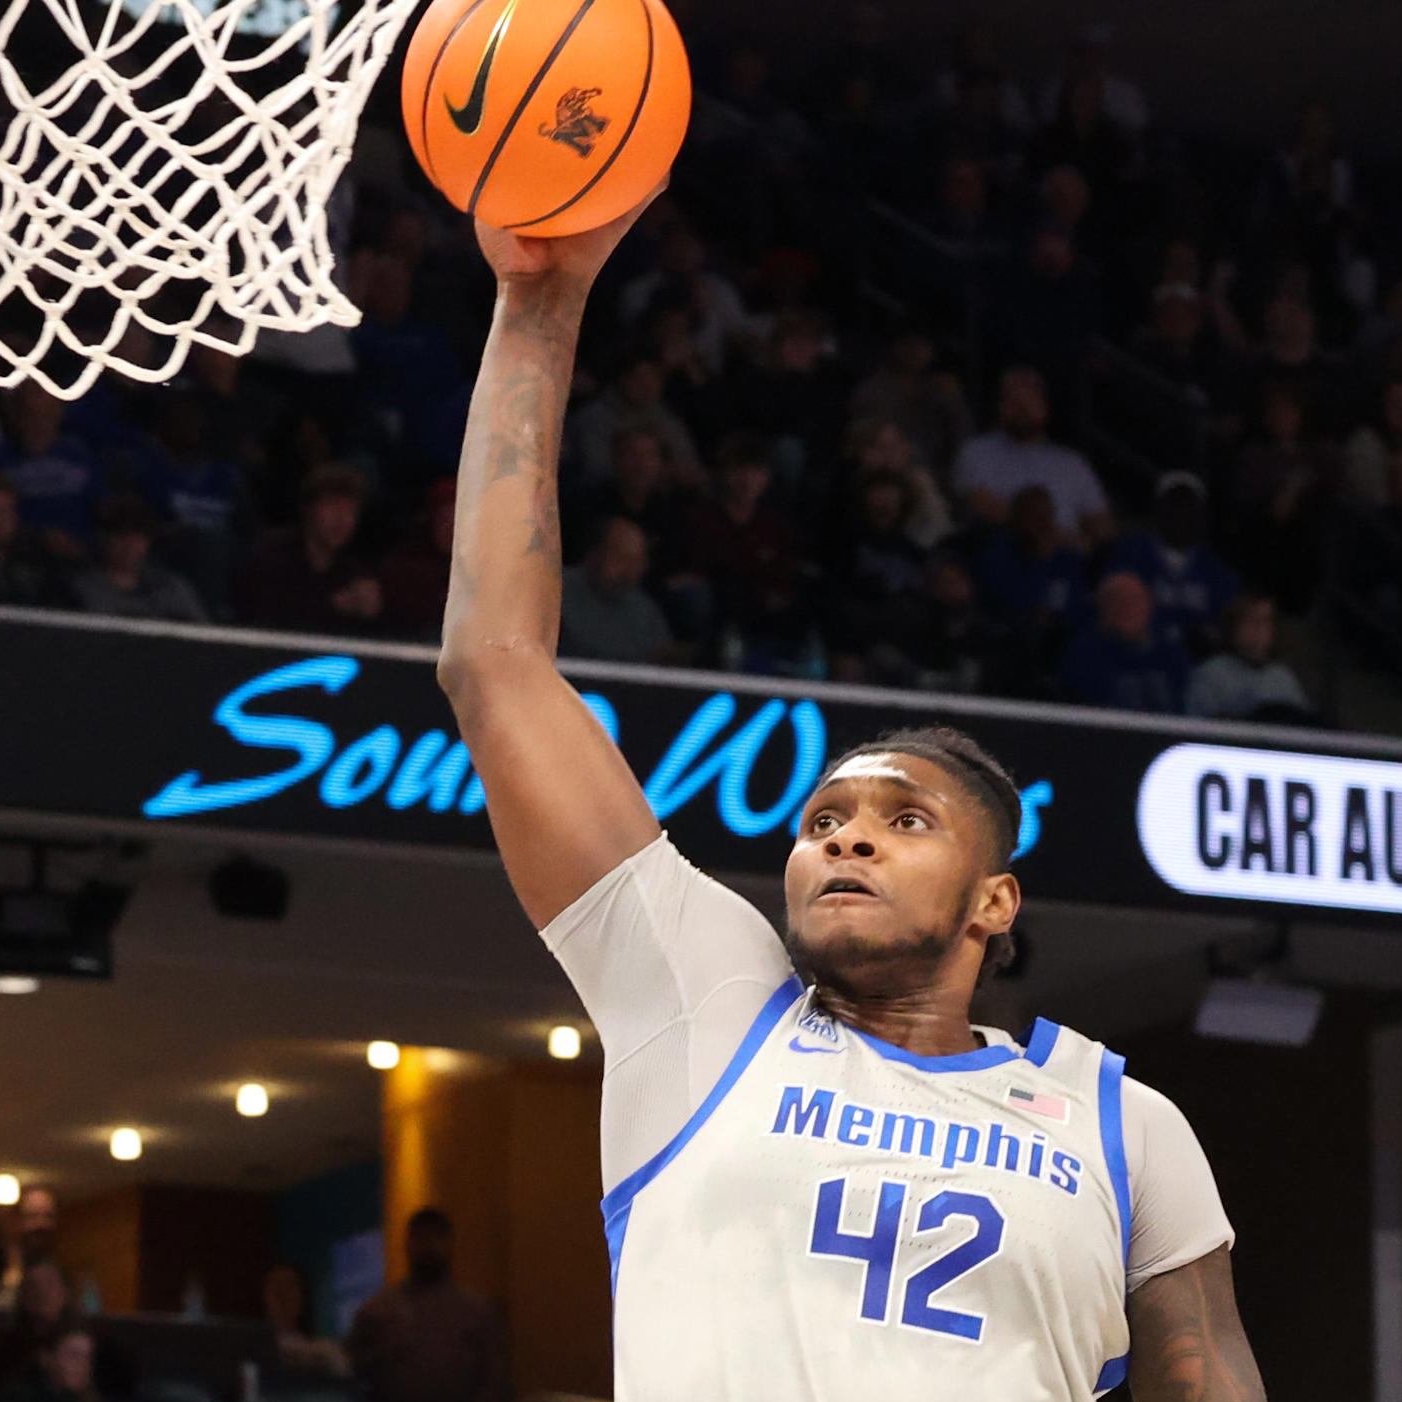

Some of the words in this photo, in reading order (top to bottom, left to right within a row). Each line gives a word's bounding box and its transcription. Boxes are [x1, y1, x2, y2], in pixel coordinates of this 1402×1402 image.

[1197, 770, 1318, 877] CAR
[770, 1084, 1084, 1198] Memphis
[807, 1176, 1006, 1344] 42
